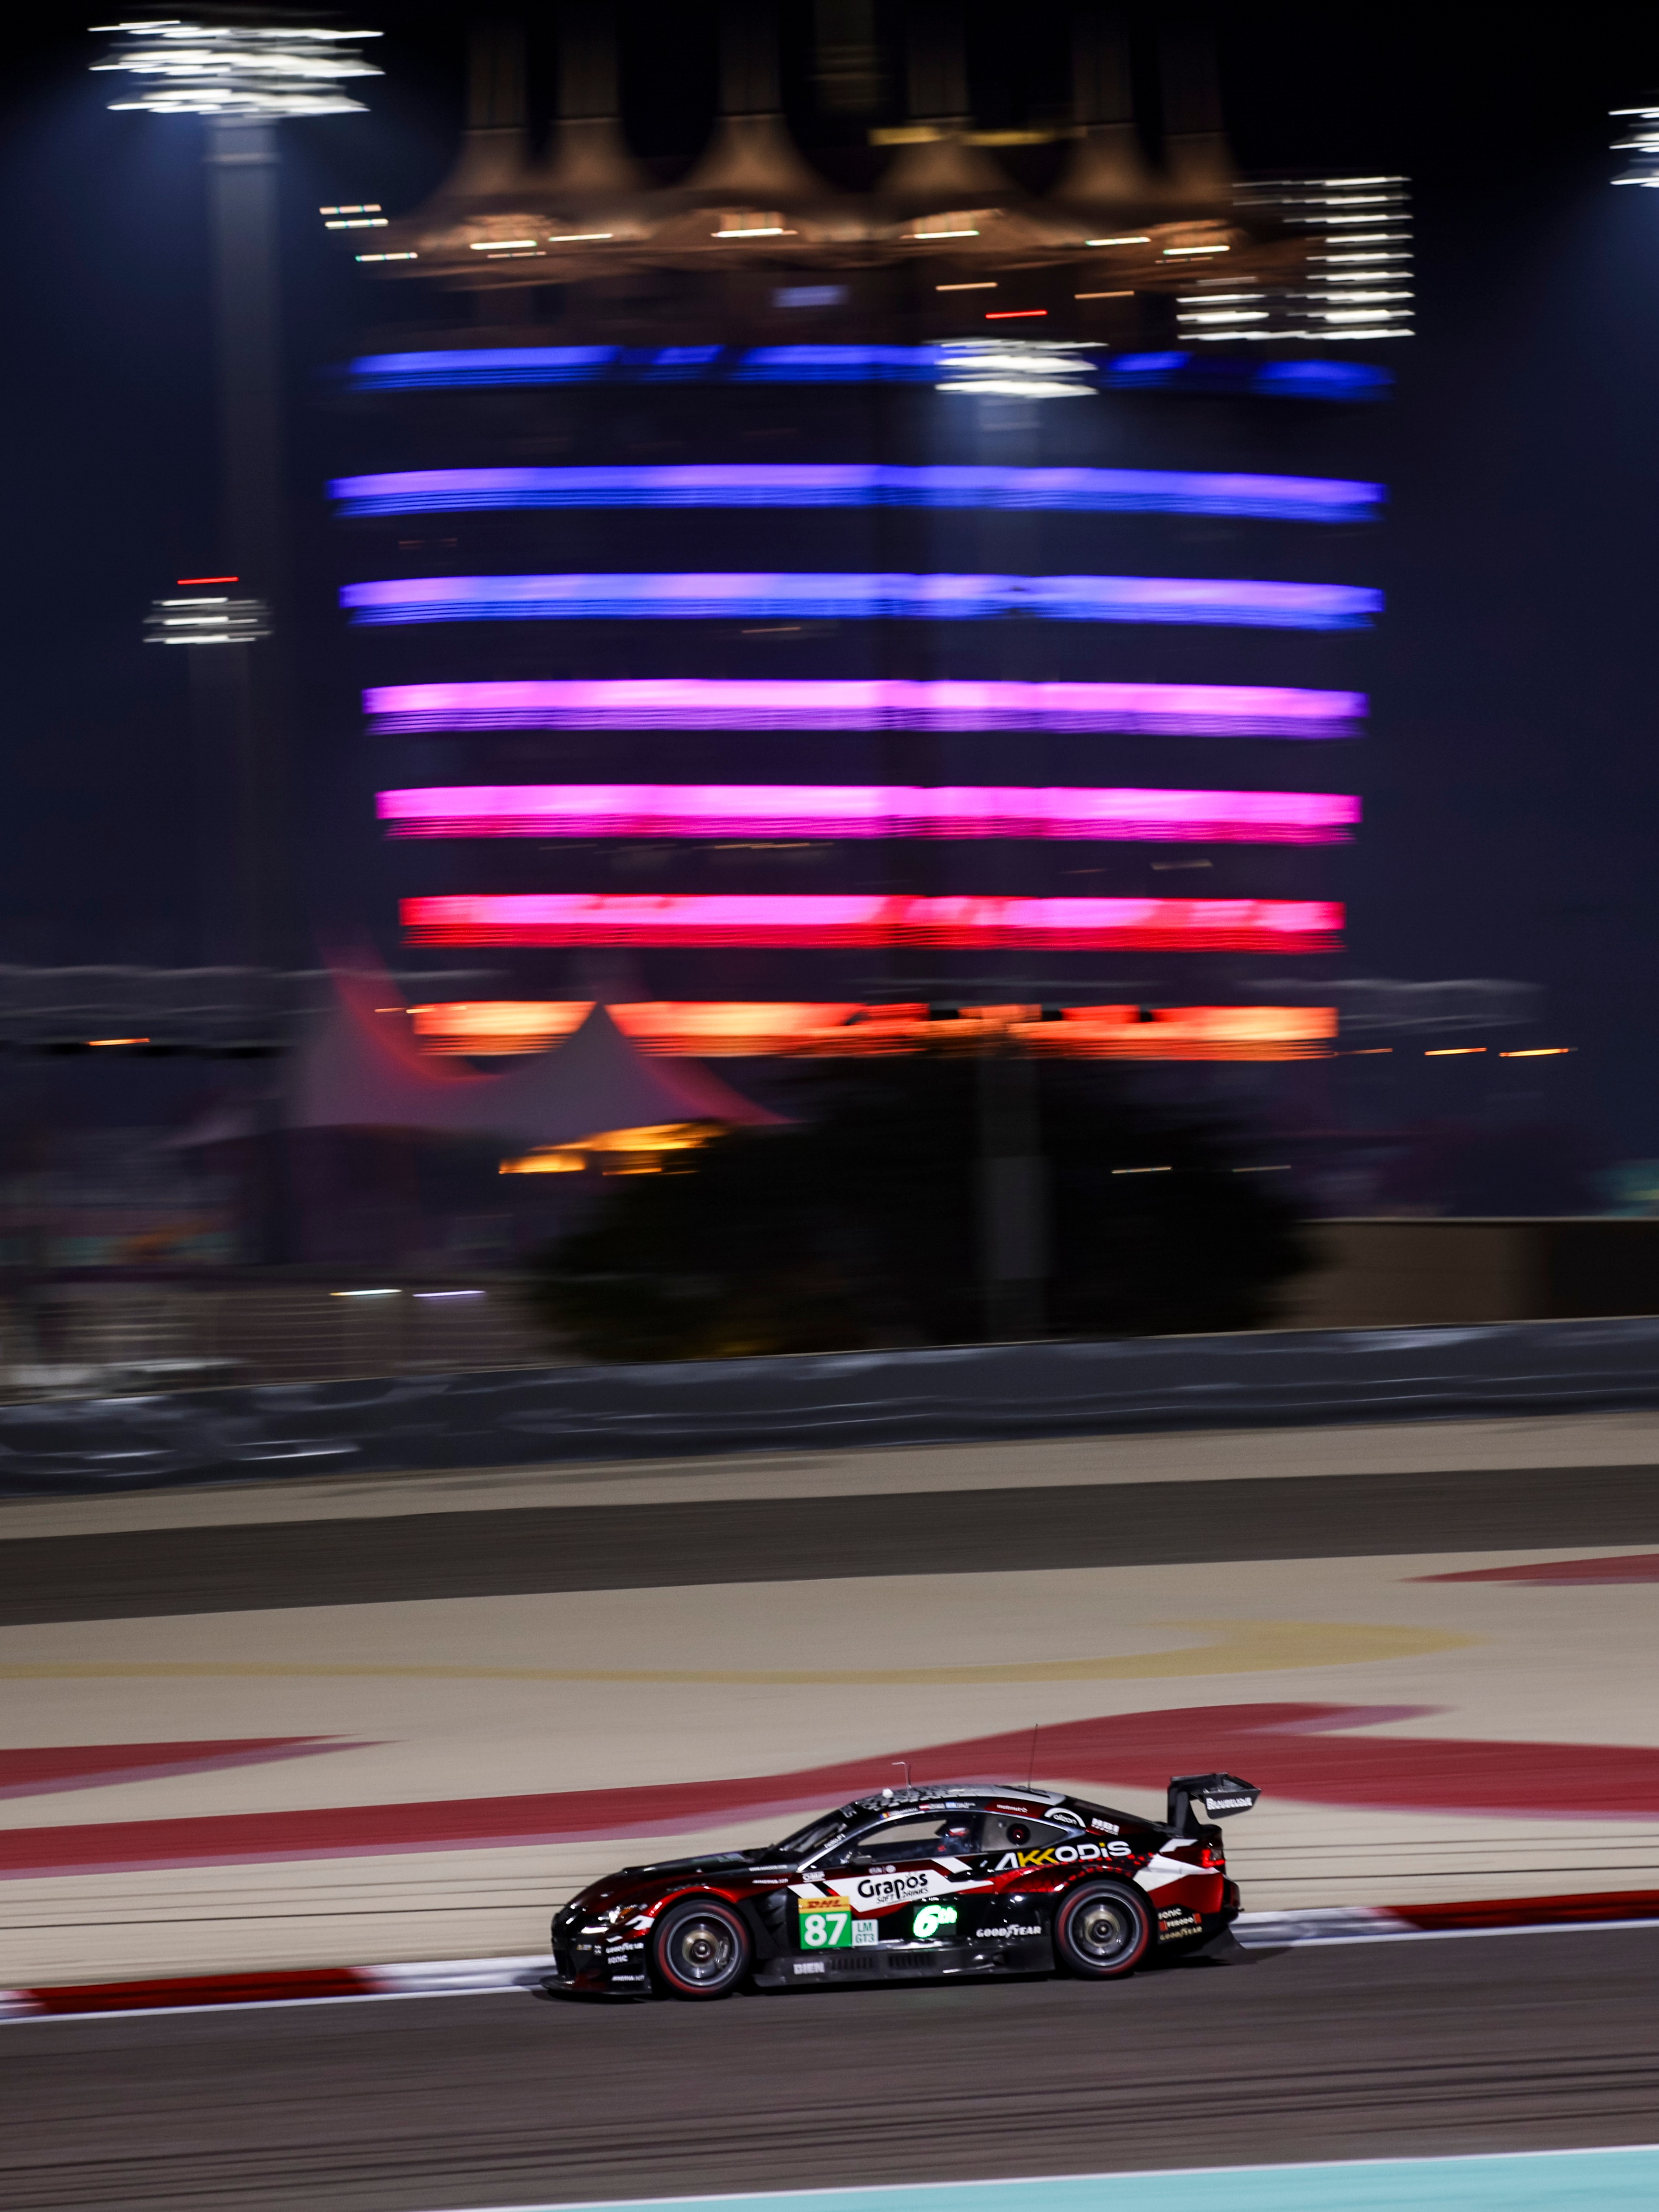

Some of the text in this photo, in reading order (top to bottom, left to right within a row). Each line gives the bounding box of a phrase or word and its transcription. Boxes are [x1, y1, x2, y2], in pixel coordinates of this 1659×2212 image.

[995, 1841, 1132, 1870] AKKODIS
[858, 1874, 928, 1899] Grapos
[804, 1913, 848, 1947] 87
[858, 1922, 872, 1932] LM
[914, 1905, 957, 1938] 6th
[976, 1924, 1041, 1938] GOODYEAR
[856, 1934, 874, 1943] GT3
